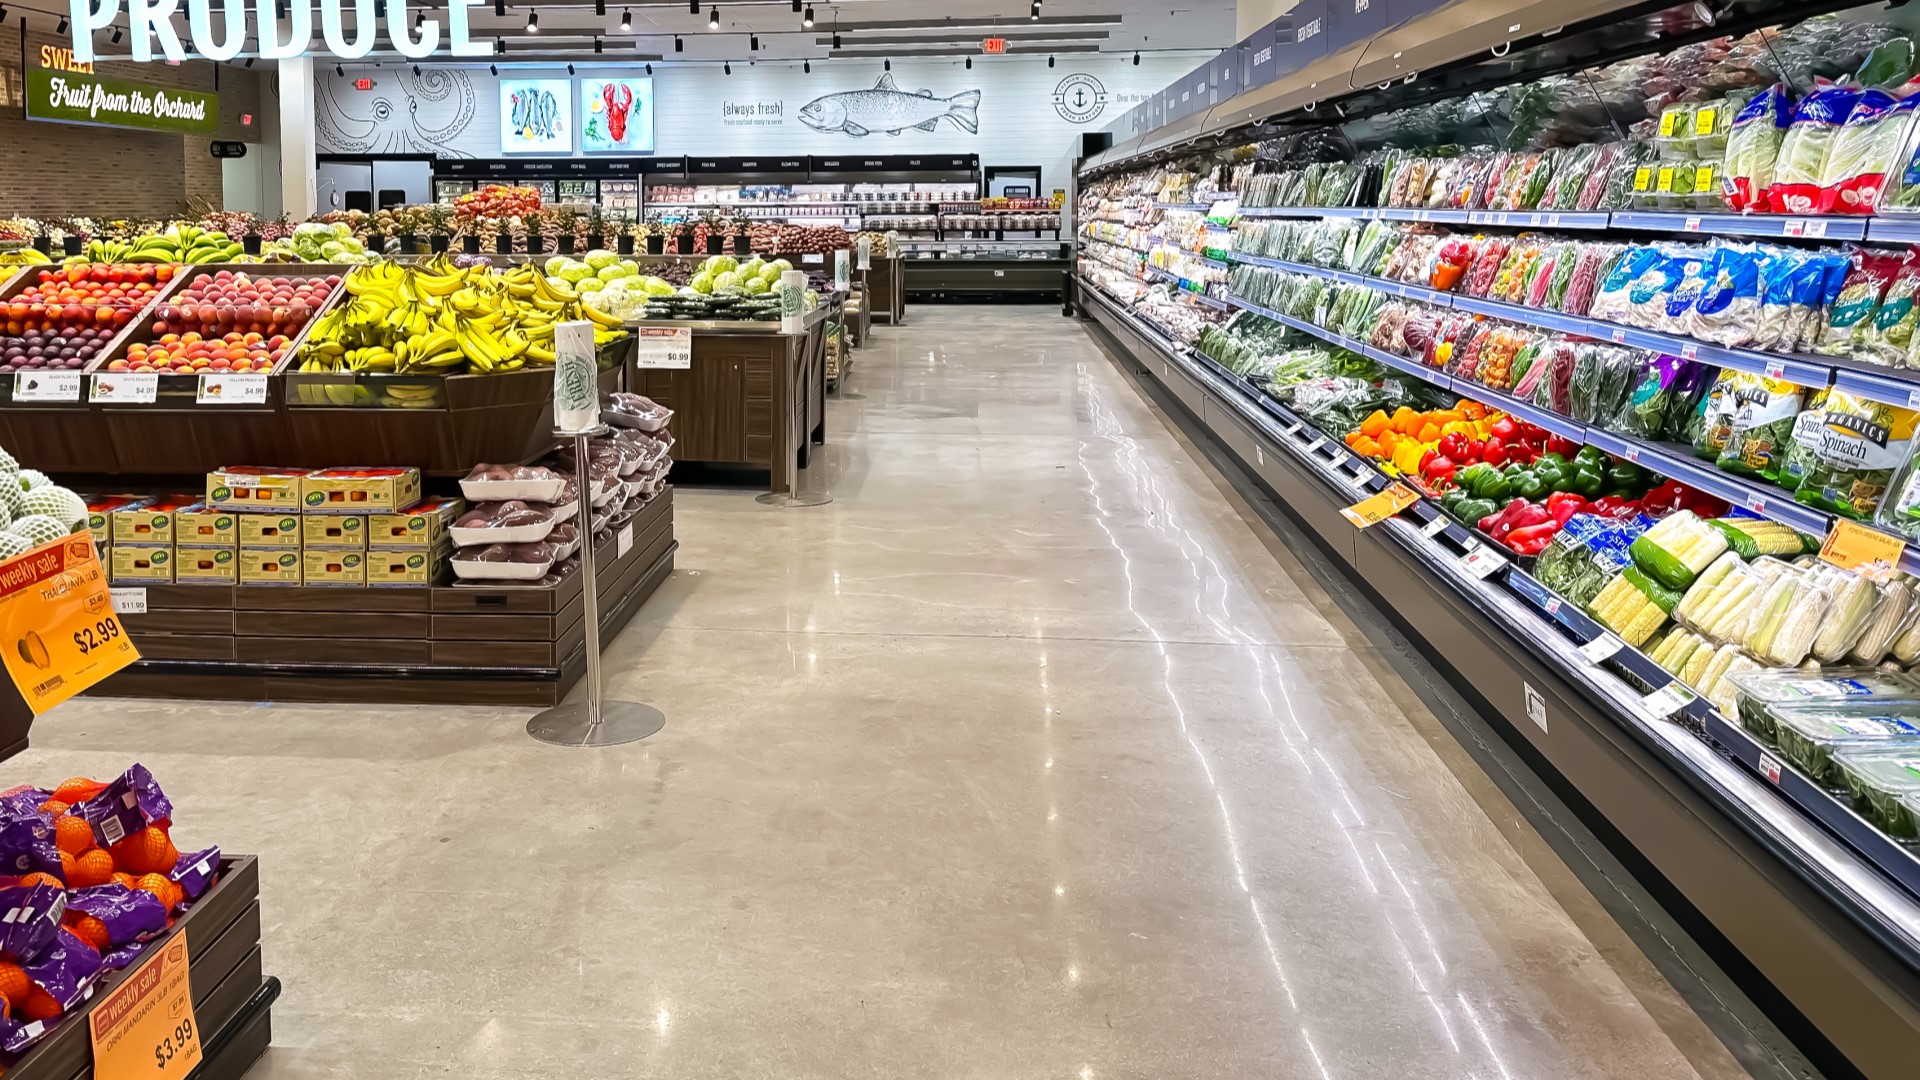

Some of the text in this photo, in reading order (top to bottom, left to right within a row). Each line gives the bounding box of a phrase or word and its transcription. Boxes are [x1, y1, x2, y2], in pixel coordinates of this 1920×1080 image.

[69, 0, 495, 62] PRODUCE
[50, 77, 205, 120] Fruit from the Orchard
[667, 352, 689, 361] $0.99
[59, 384, 78, 392] $2.99
[245, 387, 264, 395] $4.99
[1819, 430, 1867, 461] Spinach
[1, 553, 60, 591] weekly sale
[121, 601, 145, 609] $11.99
[73, 617, 119, 655] $2.99
[118, 642, 130, 653] 1LB
[108, 967, 157, 1021] weekly sale
[122, 999, 156, 1037] MANDARIN
[155, 1017, 193, 1070] $3.99
